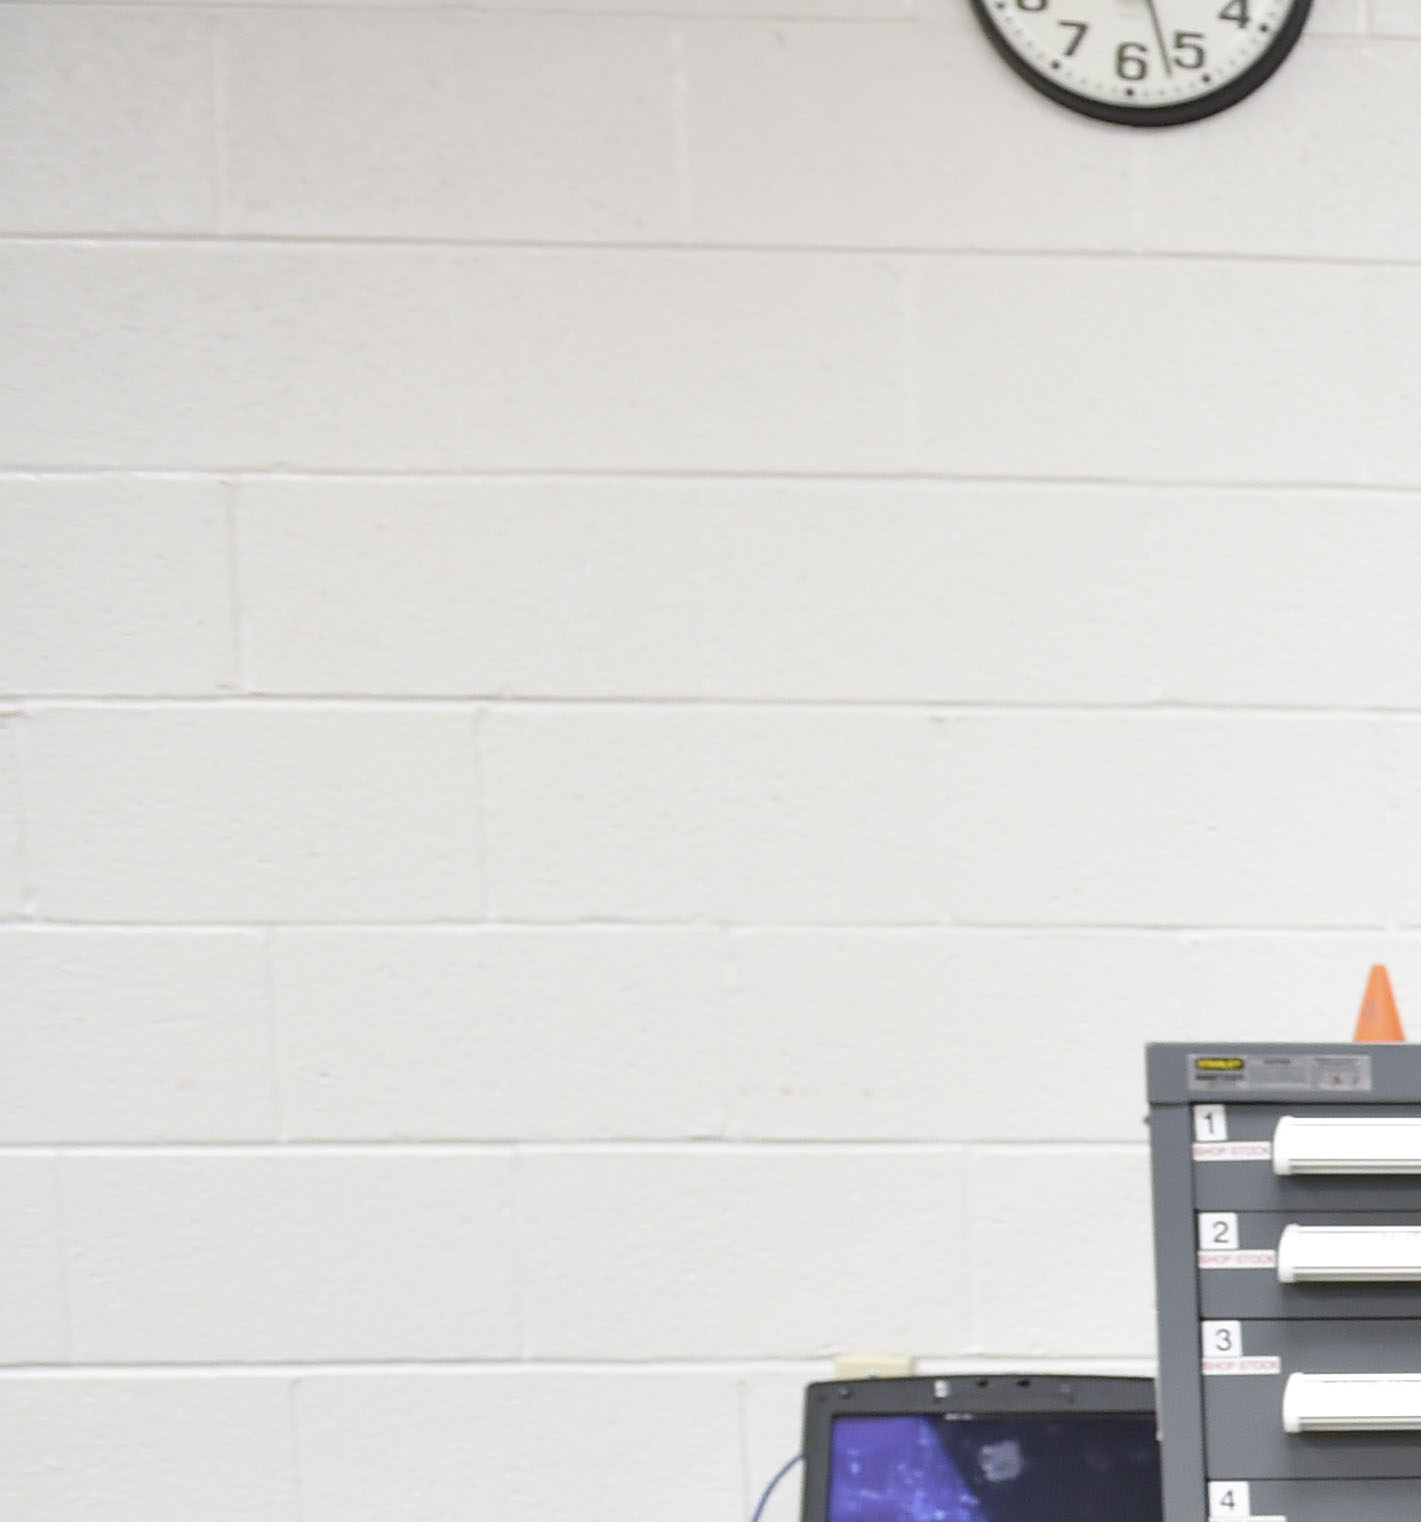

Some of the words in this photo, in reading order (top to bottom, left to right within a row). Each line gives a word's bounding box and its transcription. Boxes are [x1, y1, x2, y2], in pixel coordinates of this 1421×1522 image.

[1218, 0, 1251, 29] 4
[1059, 20, 1089, 57] 7
[1174, 31, 1205, 70] 5
[1115, 42, 1148, 80] 6
[1204, 1112, 1215, 1134] 1
[1213, 1221, 1229, 1244] 2
[1216, 1329, 1232, 1351] 3
[1220, 1490, 1235, 1511] 4
